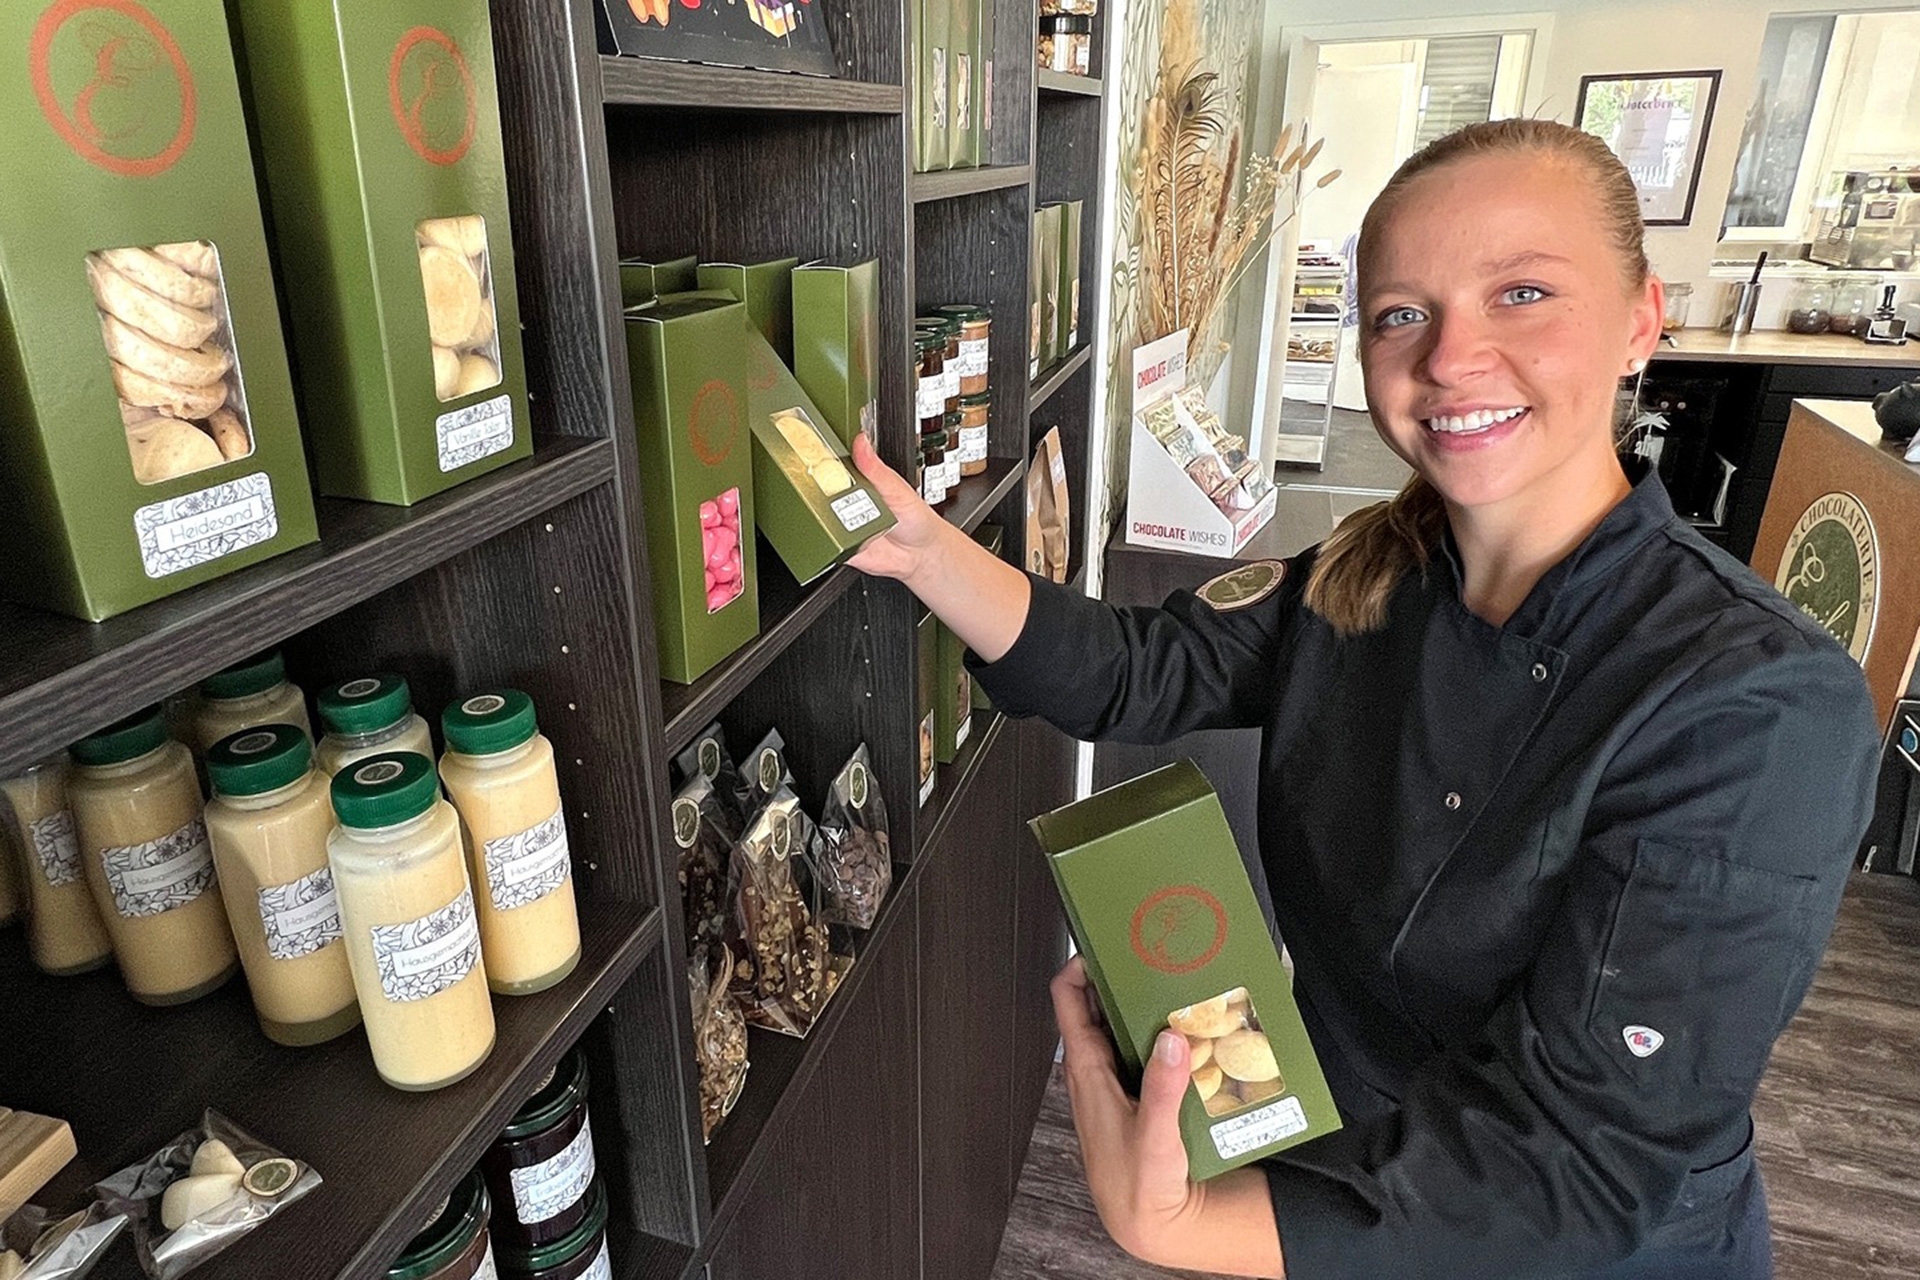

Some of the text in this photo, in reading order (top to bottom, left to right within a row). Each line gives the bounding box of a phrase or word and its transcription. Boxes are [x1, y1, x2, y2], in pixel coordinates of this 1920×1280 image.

[170, 502, 253, 543] Heidesand
[1133, 521, 1187, 541] CHOCOLATE
[1800, 498, 1874, 587] CHOCOLATERIE
